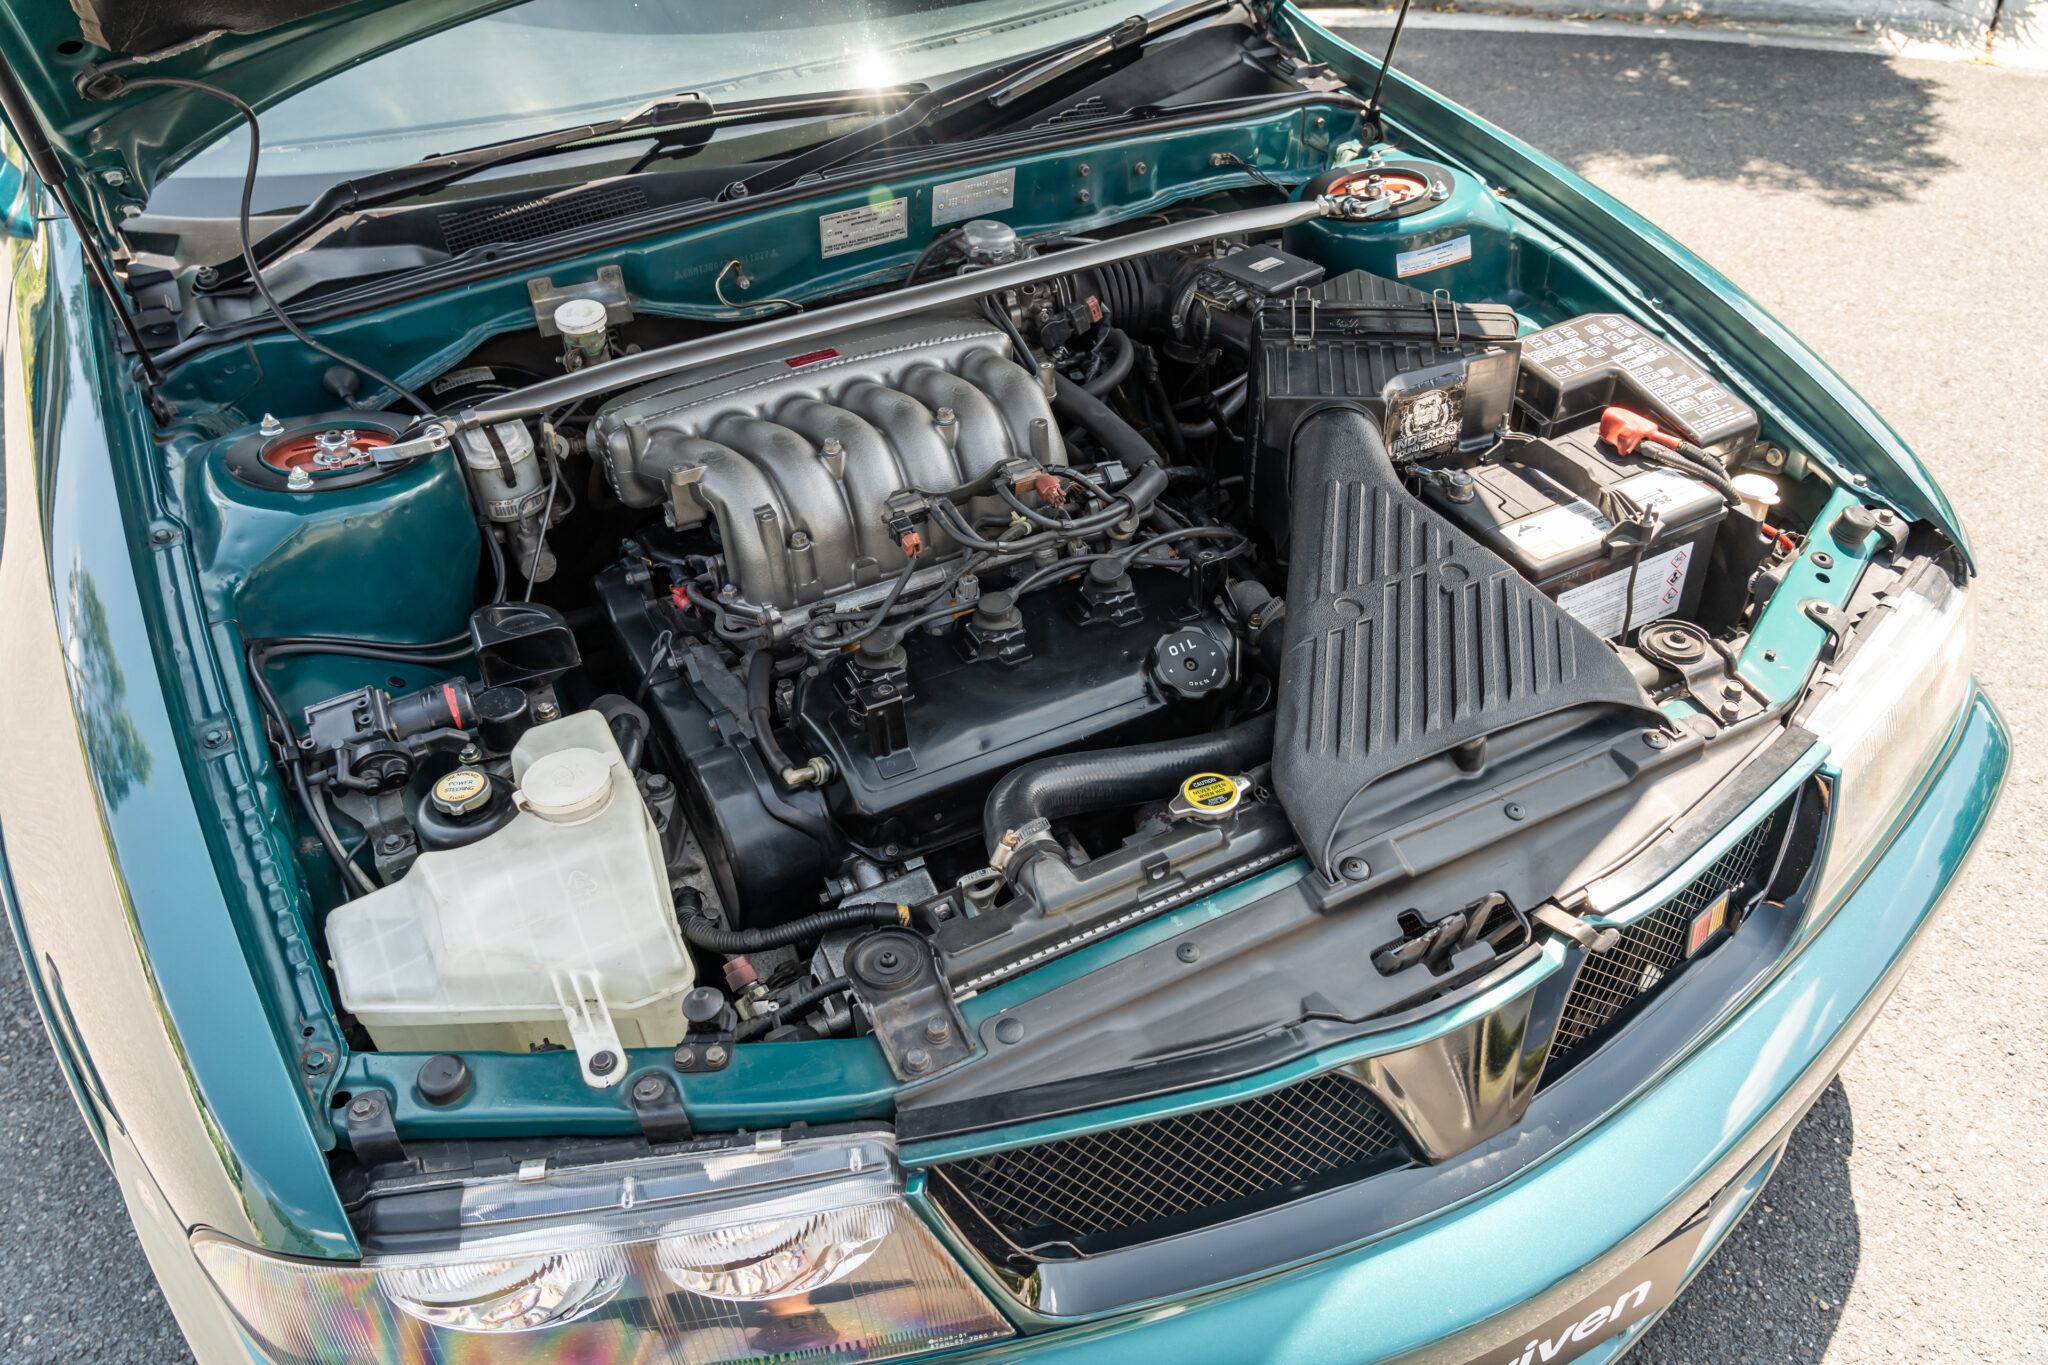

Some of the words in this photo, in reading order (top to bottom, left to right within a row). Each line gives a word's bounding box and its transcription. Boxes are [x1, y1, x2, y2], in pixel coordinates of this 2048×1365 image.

[1396, 444, 1420, 460] SOUND
[1168, 639, 1197, 656] OIL
[1188, 678, 1210, 686] OPEN
[1193, 777, 1217, 787] CAUTION
[1193, 786, 1211, 796] NEVER
[1211, 782, 1227, 791] OPEN
[1199, 790, 1215, 799] WHEN
[1215, 787, 1226, 795] HOT
